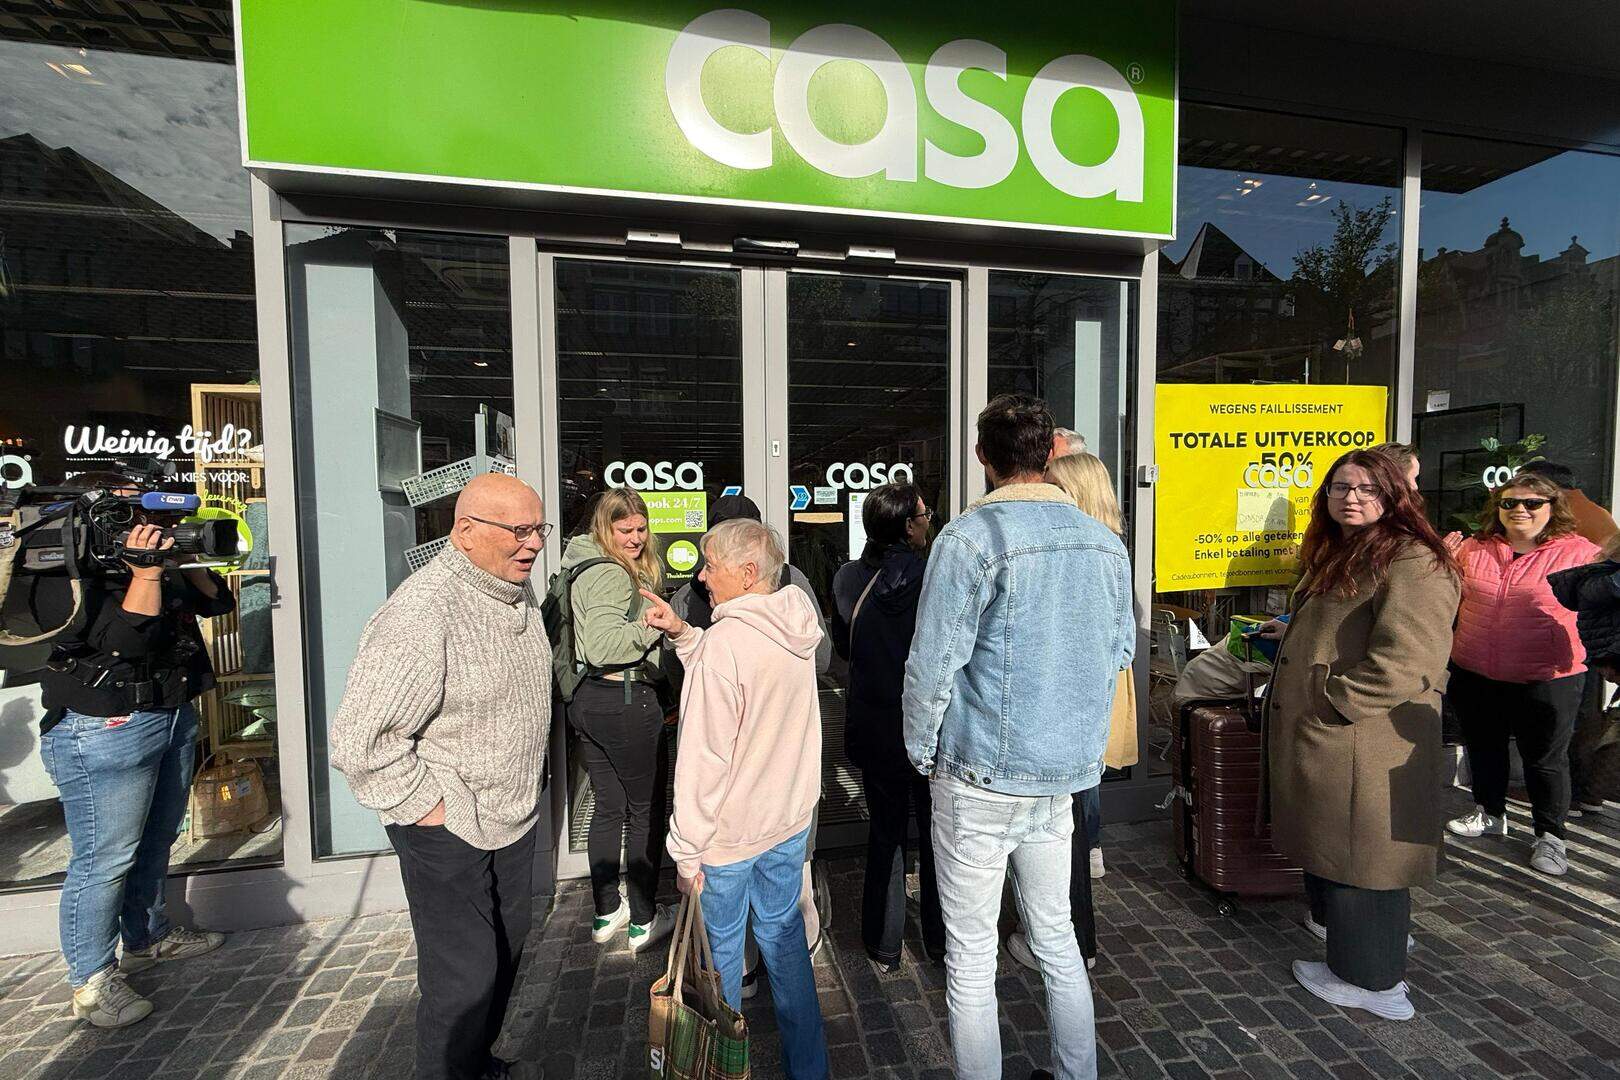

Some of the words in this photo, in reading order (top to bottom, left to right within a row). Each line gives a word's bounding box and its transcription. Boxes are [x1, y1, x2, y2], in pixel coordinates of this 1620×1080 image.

[1209, 404, 1257, 414] WEGENS
[1260, 404, 1344, 414] FAILLISSEMENT
[64, 424, 176, 460] Weinig
[175, 423, 252, 464] tijd?
[1169, 432, 1248, 449] TOTALE
[1255, 431, 1376, 448] UITVERKOOP
[181, 472, 207, 483] KIES
[209, 471, 250, 484] VOOR:
[1243, 464, 1313, 489] casa
[673, 497, 701, 510] 24/7
[1194, 533, 1223, 545] -50%
[1226, 535, 1239, 545] op
[1242, 532, 1261, 542] alle
[1194, 548, 1224, 560] Enkel
[1226, 546, 1271, 559] betaling
[1273, 546, 1294, 556] met
